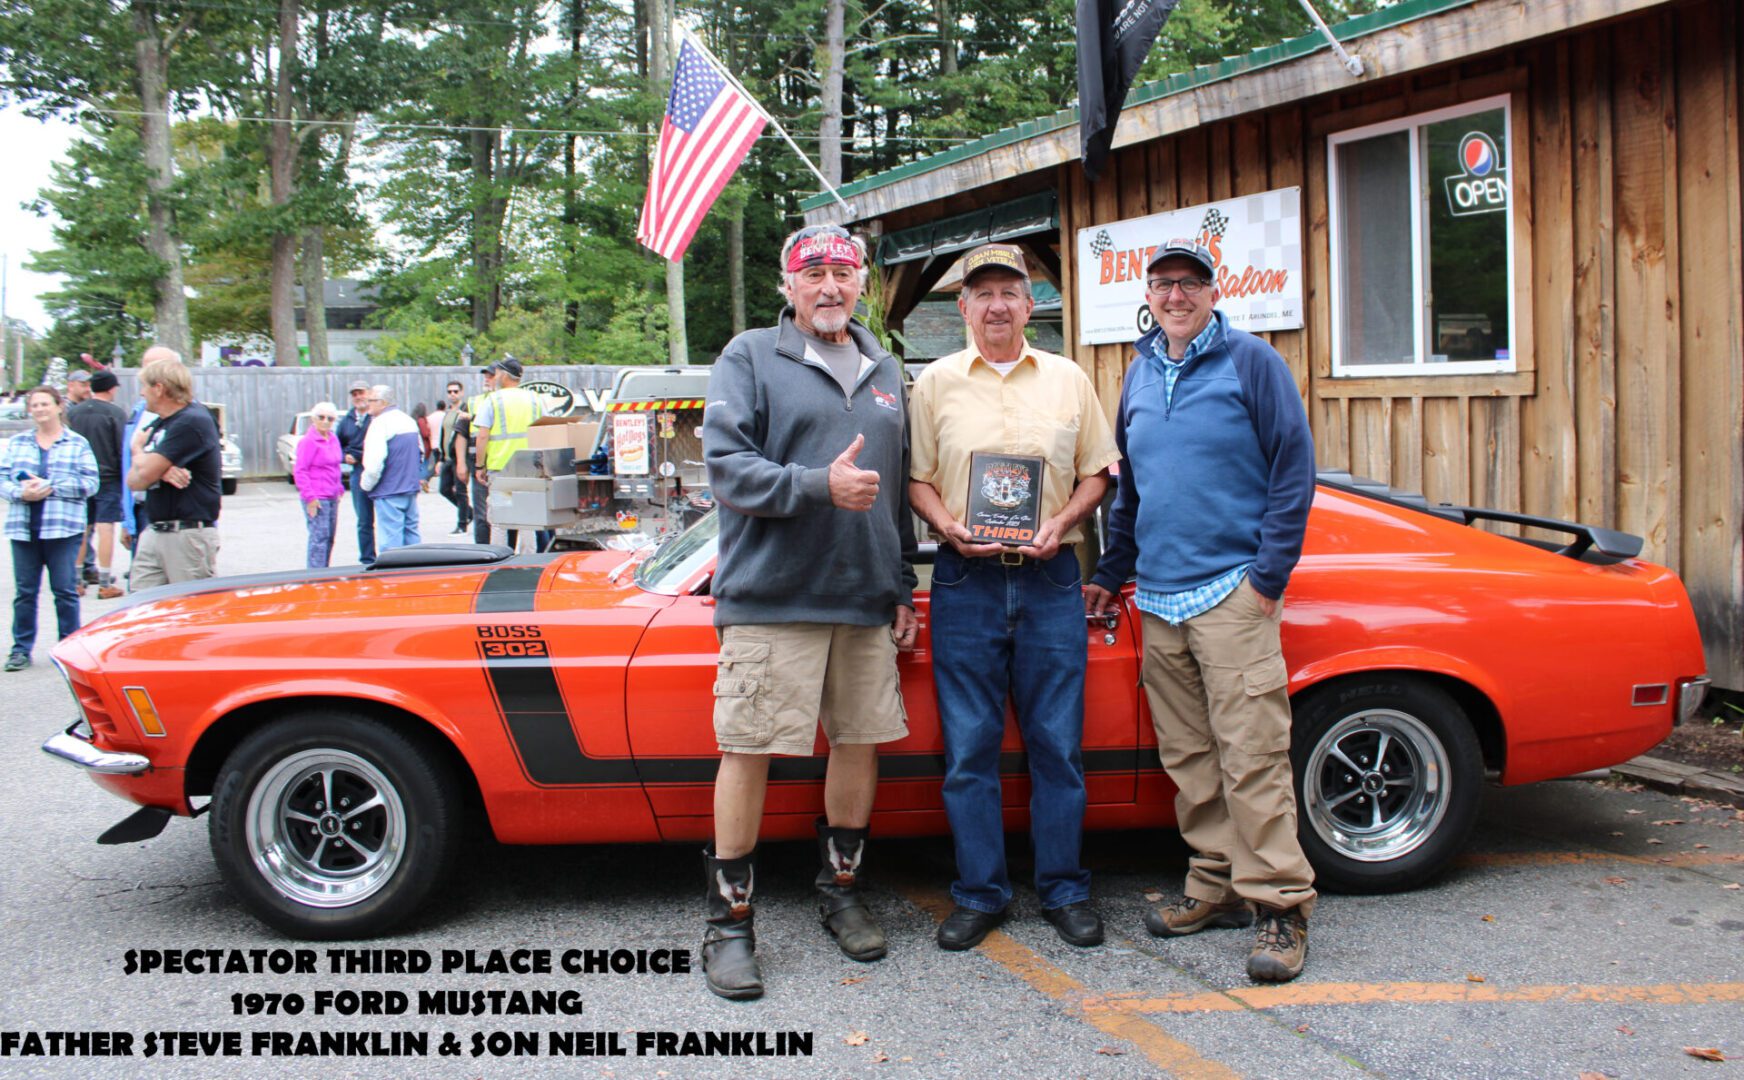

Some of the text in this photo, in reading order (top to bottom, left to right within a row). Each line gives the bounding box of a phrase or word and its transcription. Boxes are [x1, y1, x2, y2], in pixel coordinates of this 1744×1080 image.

[1119, 1, 1149, 34] ARE NOT
[1455, 177, 1508, 207] OPEN
[1216, 264, 1289, 299] Saloon
[522, 384, 568, 396] ICTORY
[972, 524, 1034, 541] THIRD
[477, 625, 541, 638] BOSS
[485, 642, 546, 656] 302
